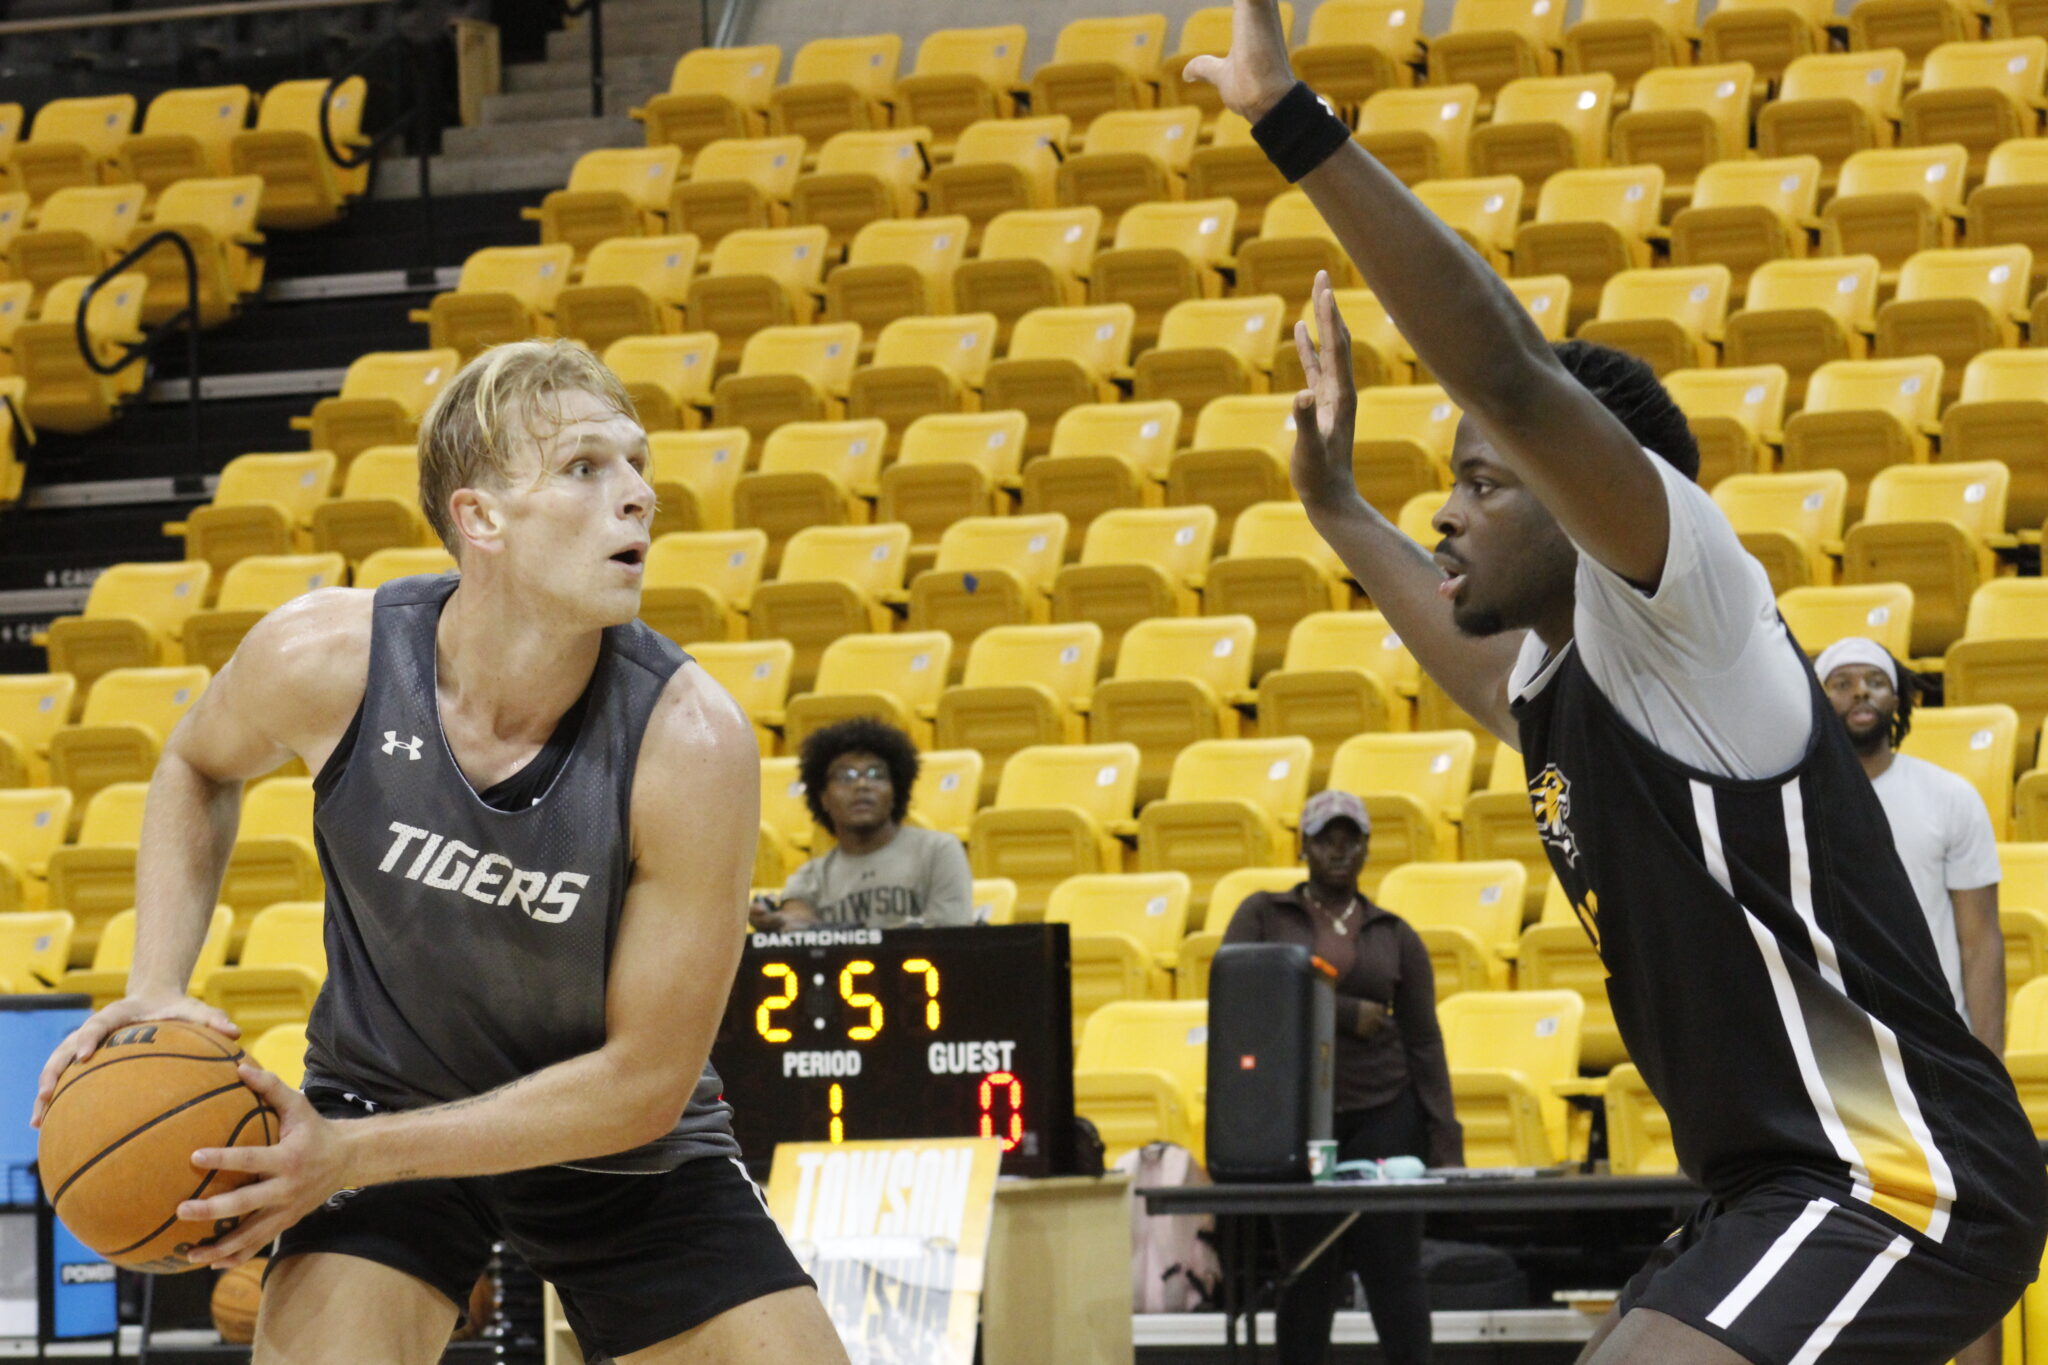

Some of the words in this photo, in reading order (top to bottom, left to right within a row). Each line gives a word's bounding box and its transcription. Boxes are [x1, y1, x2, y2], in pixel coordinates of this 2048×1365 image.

[378, 821, 591, 924] TIGERS
[752, 929, 882, 948] DAKTRONICS
[783, 1050, 862, 1077] PERIOD
[928, 1041, 1016, 1074] GUEST
[829, 1083, 843, 1145] 1
[979, 1071, 1024, 1152] 0
[790, 1147, 975, 1240] TOWSON
